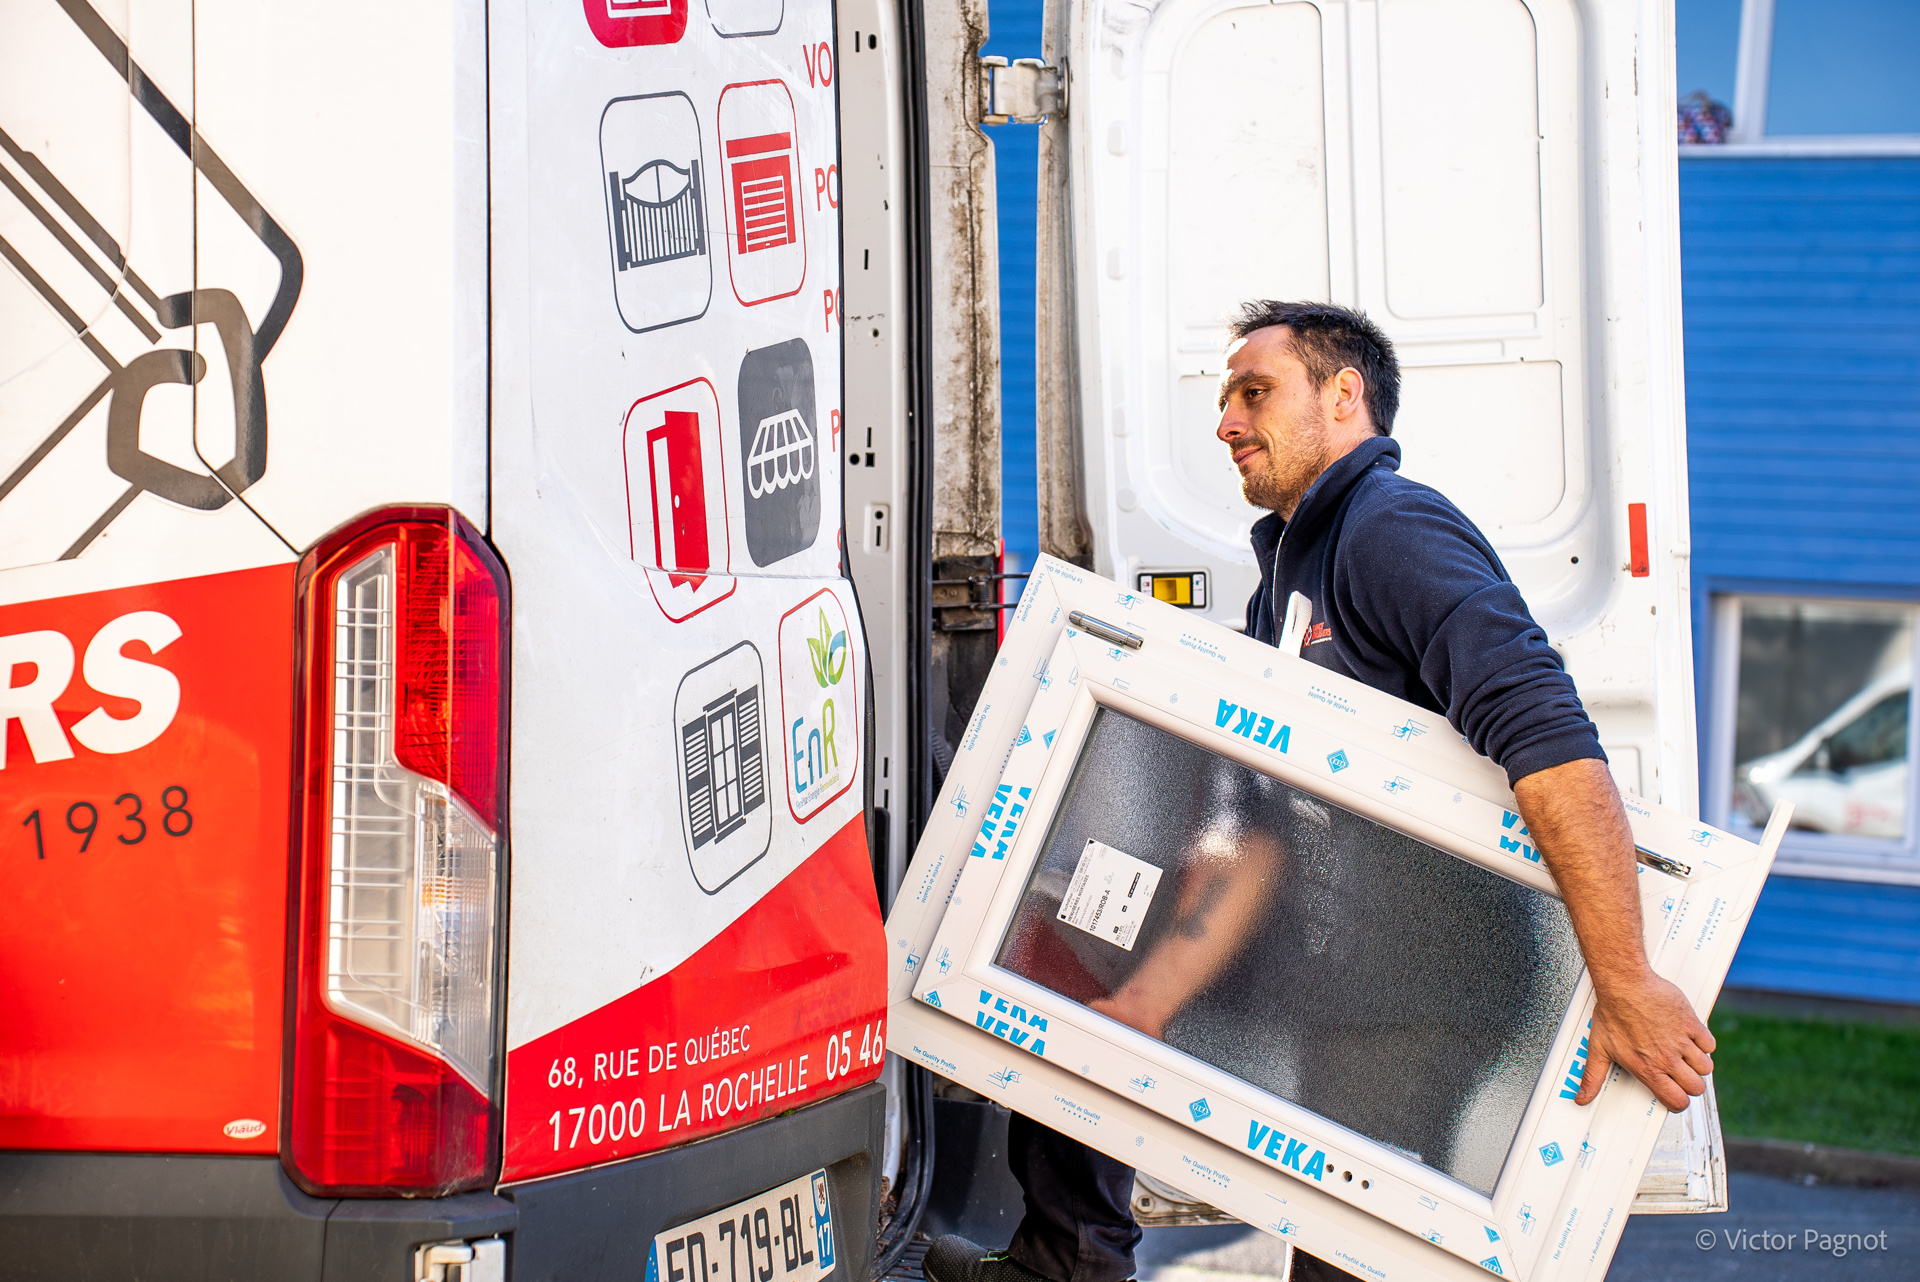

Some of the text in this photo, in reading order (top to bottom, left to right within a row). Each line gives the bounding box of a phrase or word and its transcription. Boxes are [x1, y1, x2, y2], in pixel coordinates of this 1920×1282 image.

[1216, 653, 1226, 661] The
[0, 611, 183, 770] RS
[982, 703, 990, 714] The
[792, 698, 838, 794] EnR
[1215, 698, 1291, 754] VEKA
[22, 785, 193, 860] 1938
[547, 1024, 750, 1090] 68, RUE DE QUÉBEC
[911, 1045, 922, 1054] The
[548, 1019, 883, 1152] 17000 LA ROCHELLE 05 46
[1181, 1155, 1192, 1164] The
[1191, 1159, 1212, 1175] Quality
[1247, 1119, 1326, 1182] VEKA
[818, 1221, 831, 1258] 17
